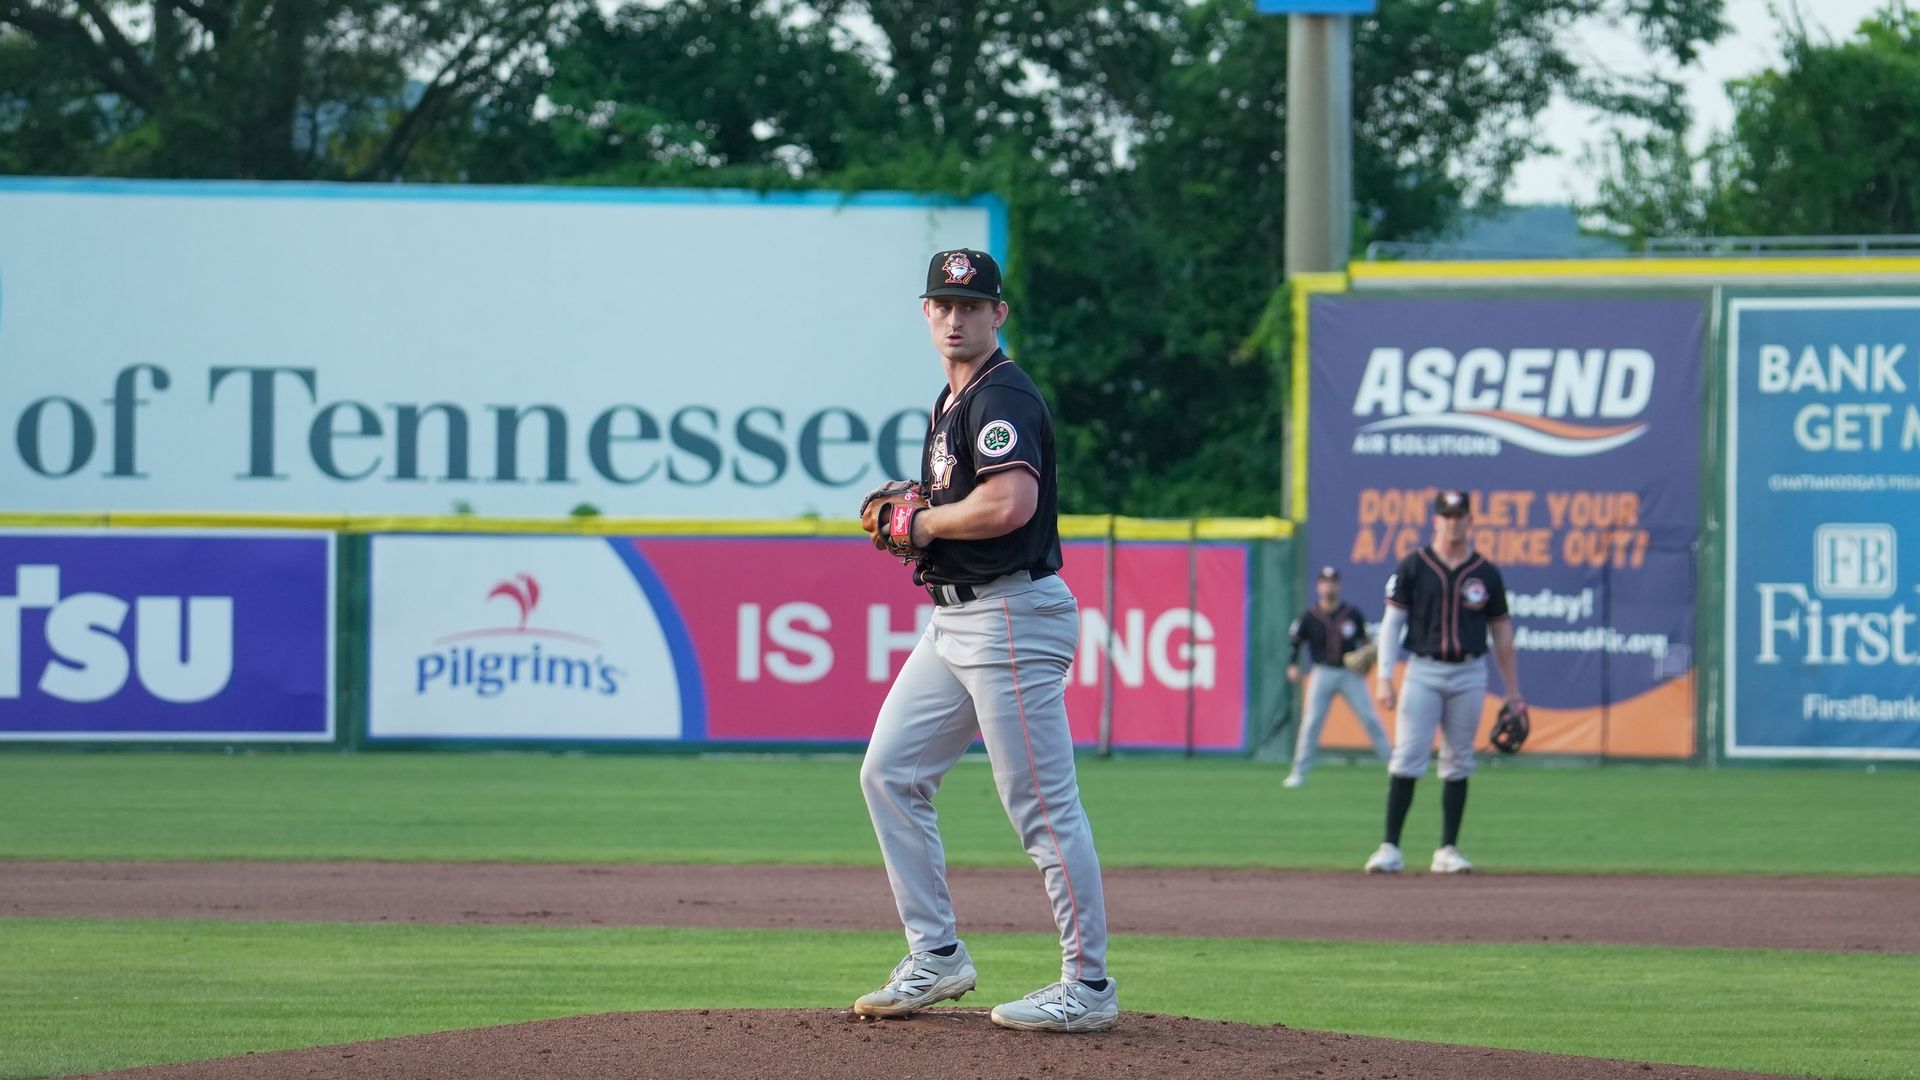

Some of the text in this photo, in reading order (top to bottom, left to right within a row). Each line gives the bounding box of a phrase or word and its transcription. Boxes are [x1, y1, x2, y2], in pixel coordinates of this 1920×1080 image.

[1352, 347, 1655, 418] ASCEND
[1758, 343, 1906, 394] BANK
[15, 362, 931, 489] of Tennessee
[1352, 432, 1502, 457] AIR SOLUTIONS
[1793, 402, 1892, 453] GET
[1358, 486, 1640, 530] DON' LET YOUR
[1466, 528, 1553, 567] RIKE
[1562, 529, 1650, 569] OUT!
[1828, 536, 1888, 585] FB
[1505, 587, 1593, 624] today!
[1755, 583, 1920, 665] First
[737, 601, 835, 684] IS
